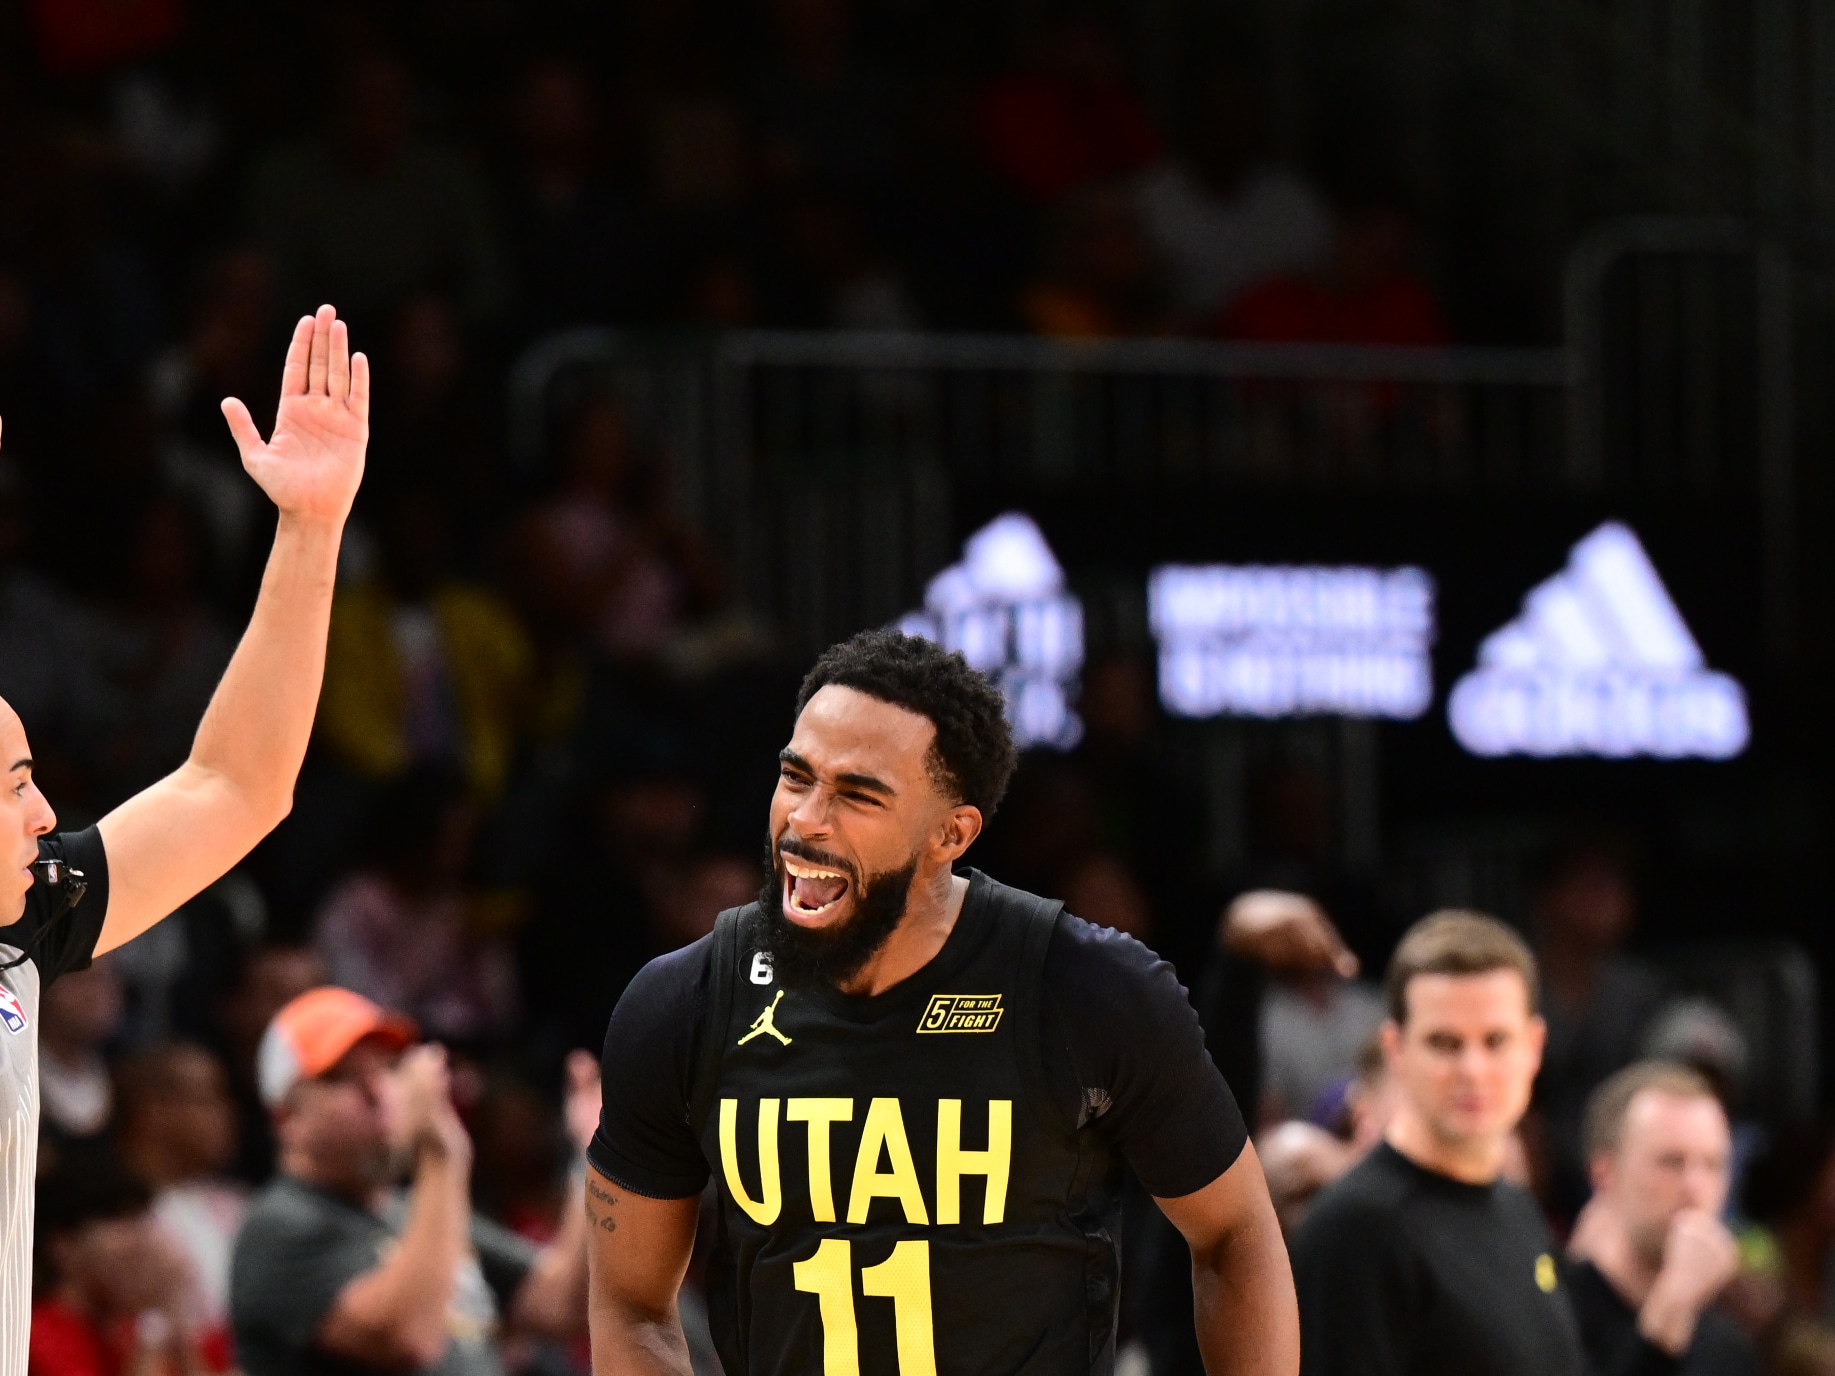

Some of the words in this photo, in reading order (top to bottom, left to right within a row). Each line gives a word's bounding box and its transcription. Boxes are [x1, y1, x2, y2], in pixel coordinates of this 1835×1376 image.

[750, 951, 774, 985] 6
[926, 1000, 951, 1029] 5
[958, 1000, 976, 1009] FOR
[977, 1000, 994, 1009] THE
[949, 1014, 996, 1028] FIGHT
[719, 1098, 1013, 1226] UTAH
